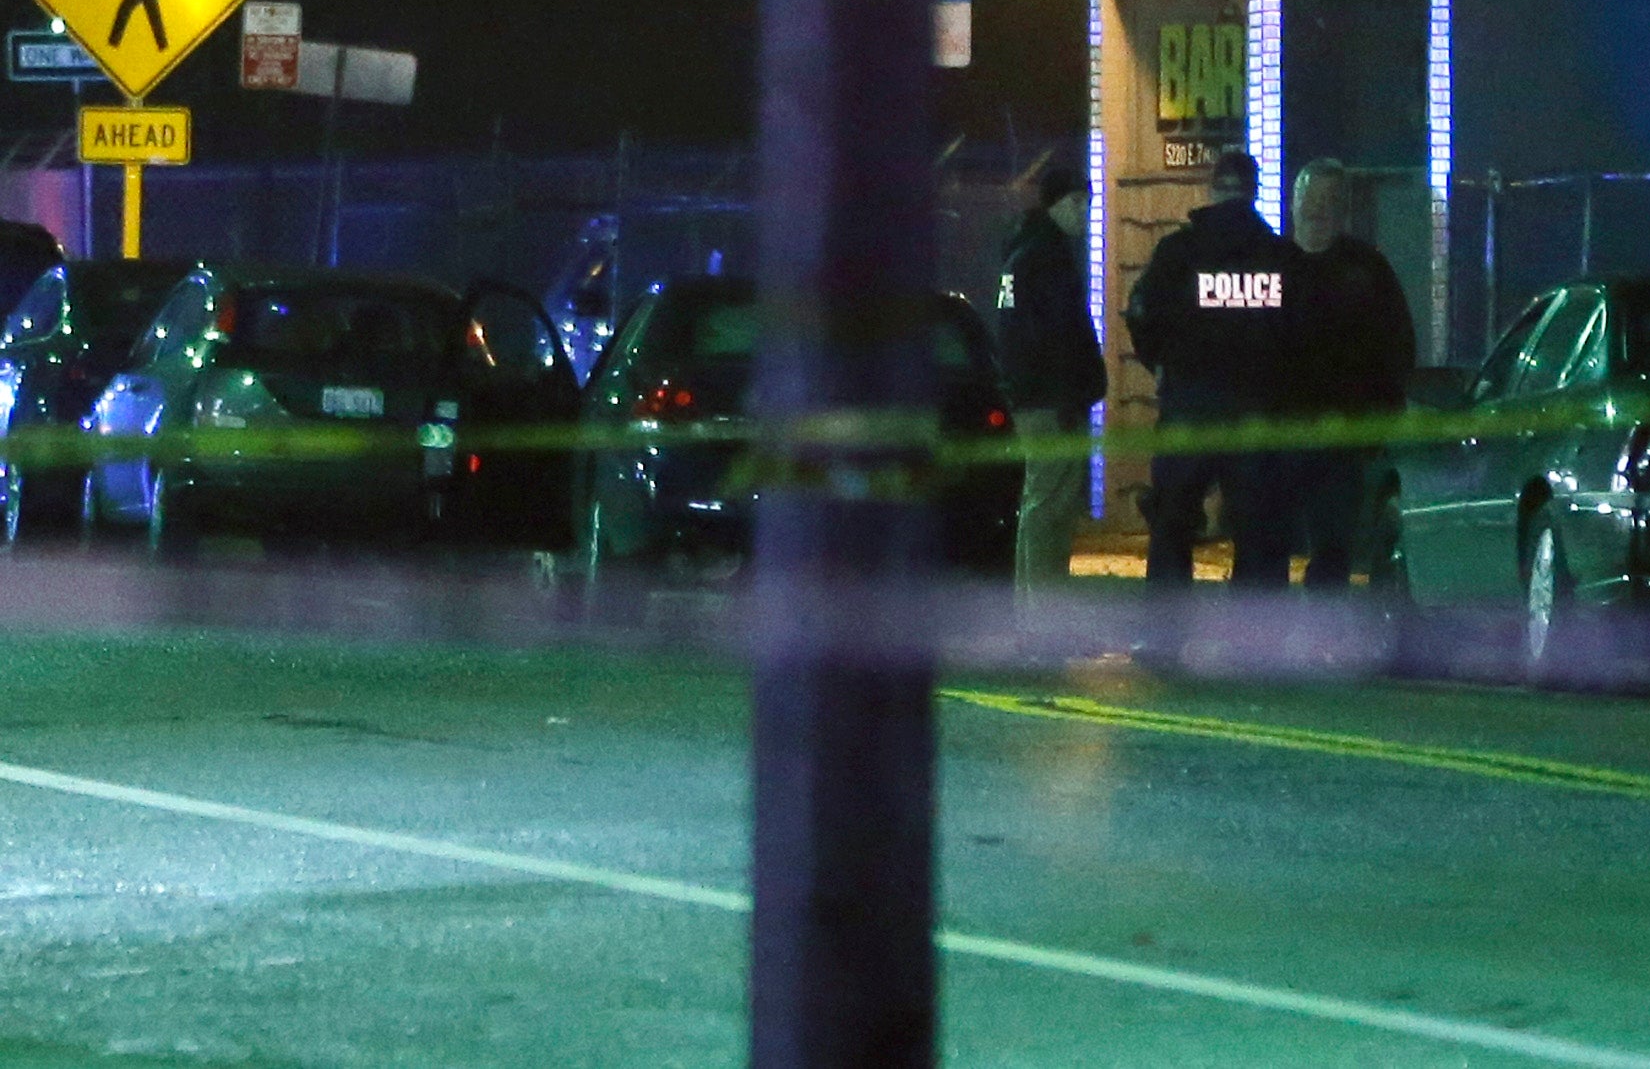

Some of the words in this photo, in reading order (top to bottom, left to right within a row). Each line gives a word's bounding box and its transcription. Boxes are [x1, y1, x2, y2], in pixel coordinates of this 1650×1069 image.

[1159, 24, 1244, 118] BAR
[94, 124, 175, 148] AHEAD
[1199, 273, 1282, 300] POLICE
